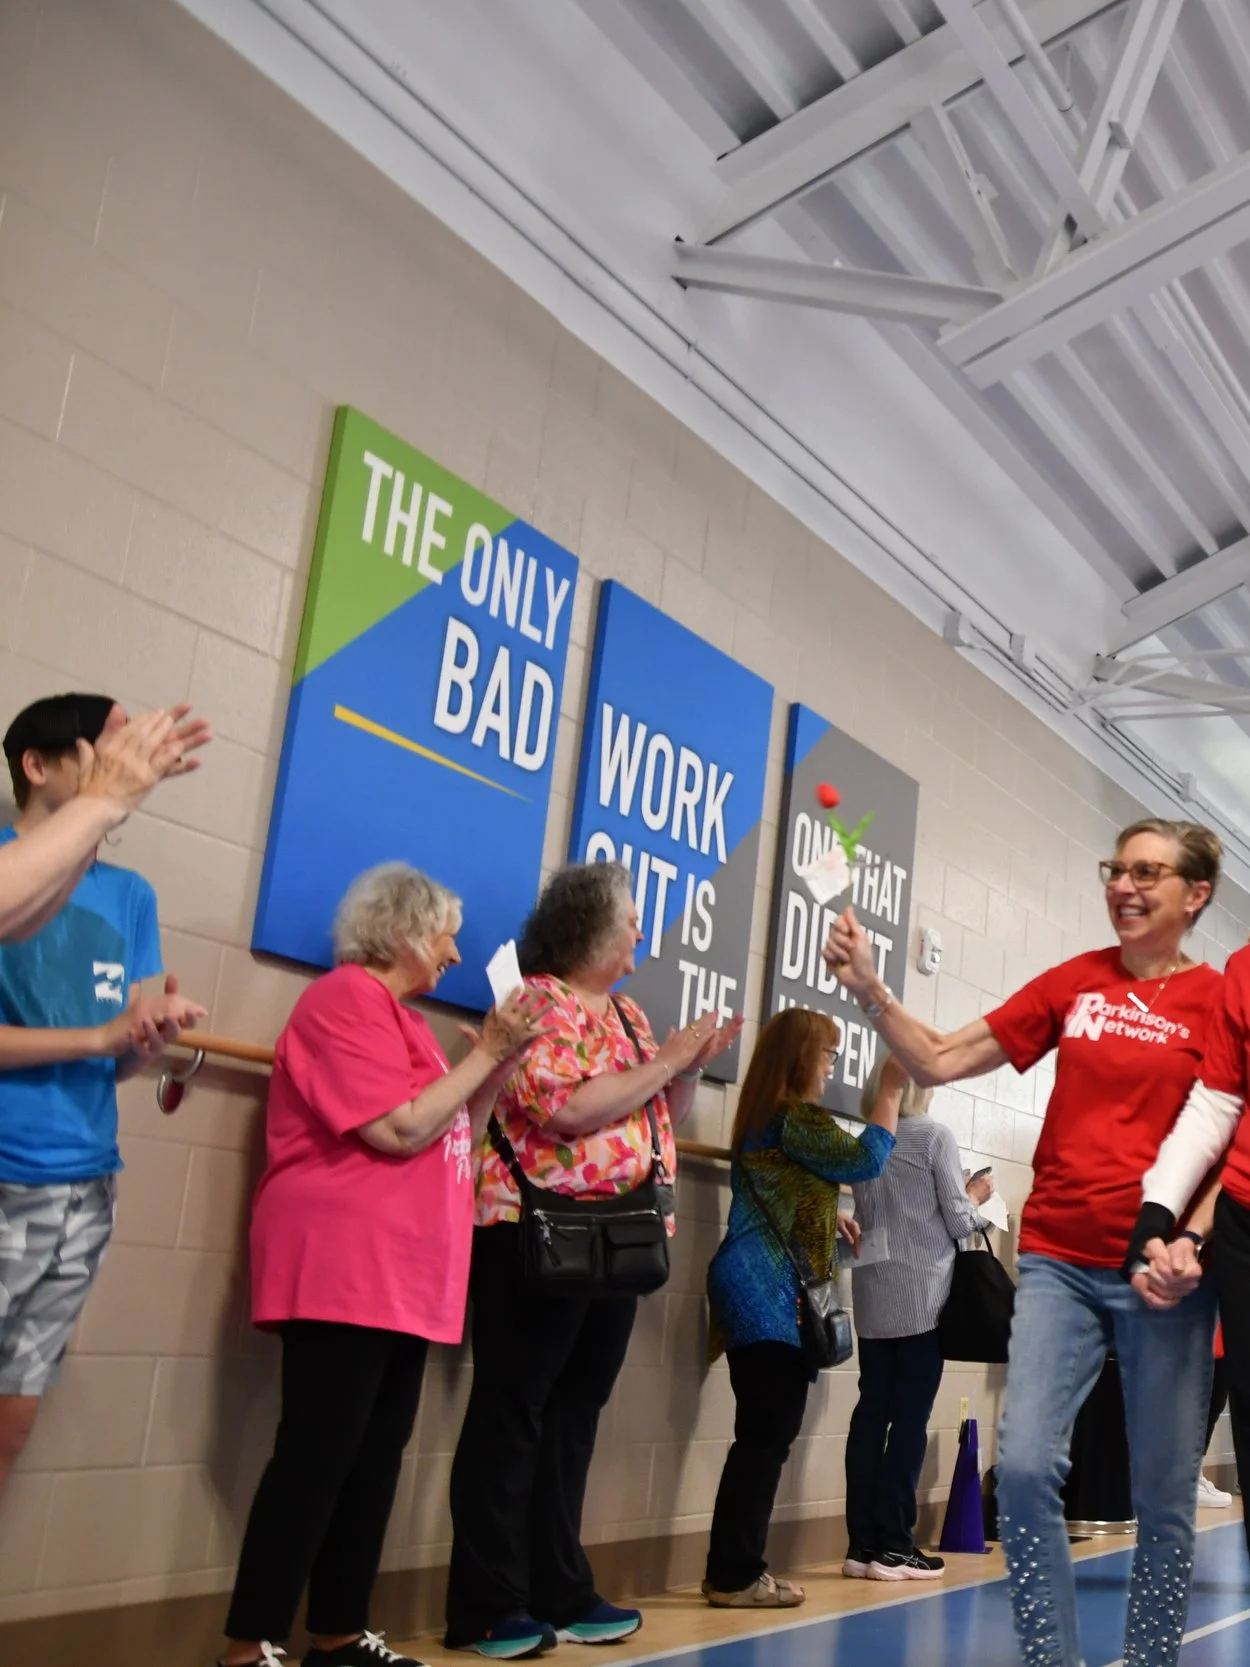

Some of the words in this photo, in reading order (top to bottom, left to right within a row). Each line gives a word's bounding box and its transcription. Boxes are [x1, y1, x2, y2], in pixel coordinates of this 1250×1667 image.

[363, 449, 453, 585] THE
[460, 522, 570, 650] ONLY
[433, 615, 555, 772] BAD
[599, 702, 734, 864] WORK
[681, 873, 716, 952] IS
[792, 812, 844, 896] ON
[852, 844, 907, 926] THAT
[679, 959, 738, 1049] THE
[782, 890, 893, 1005] DID'T
[1064, 992, 1191, 1040] Parkinson's
[1078, 1014, 1168, 1044] Network
